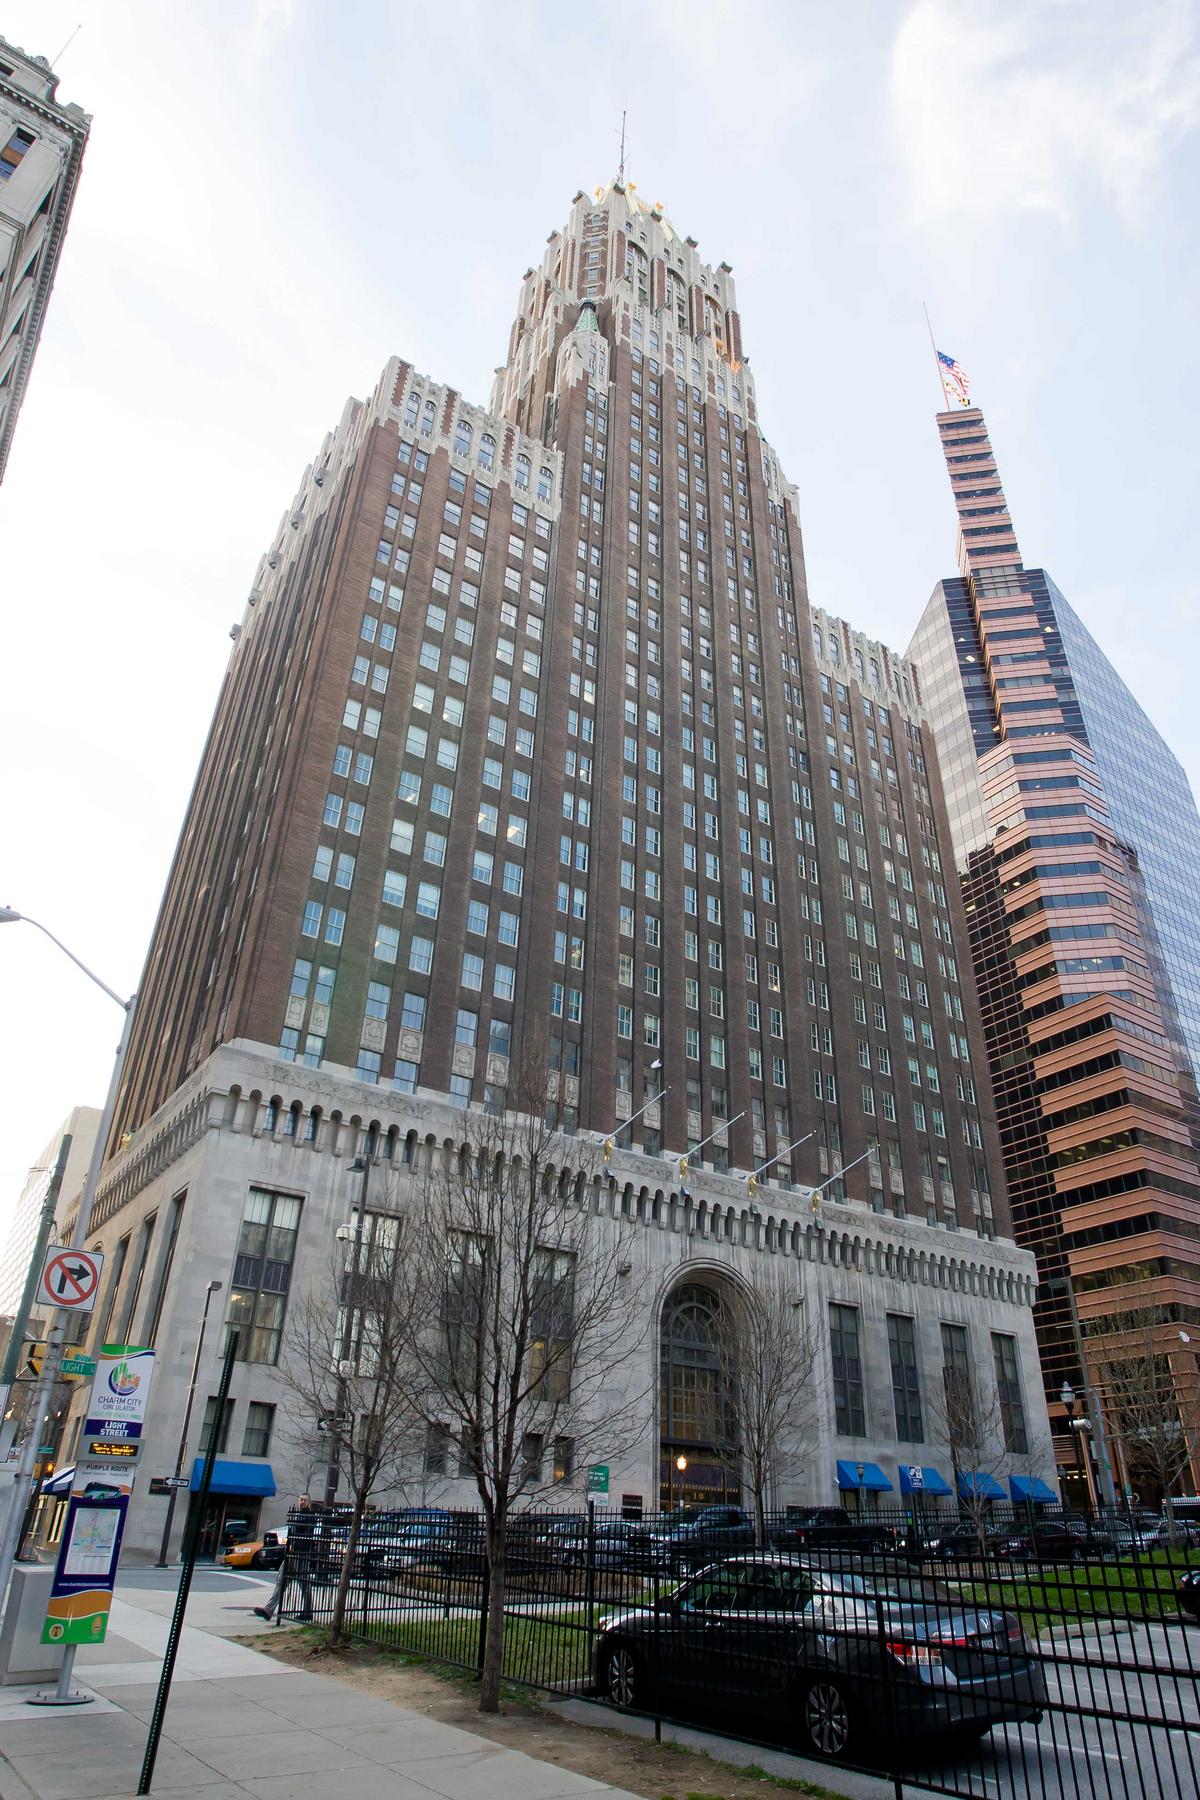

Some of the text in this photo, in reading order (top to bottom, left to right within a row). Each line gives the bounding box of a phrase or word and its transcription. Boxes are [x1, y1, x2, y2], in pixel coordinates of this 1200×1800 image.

[61, 1361, 84, 1373] LIGHT
[98, 1395, 126, 1405] CHARM
[104, 1421, 128, 1430] LIGHT
[100, 1428, 129, 1437] STREET
